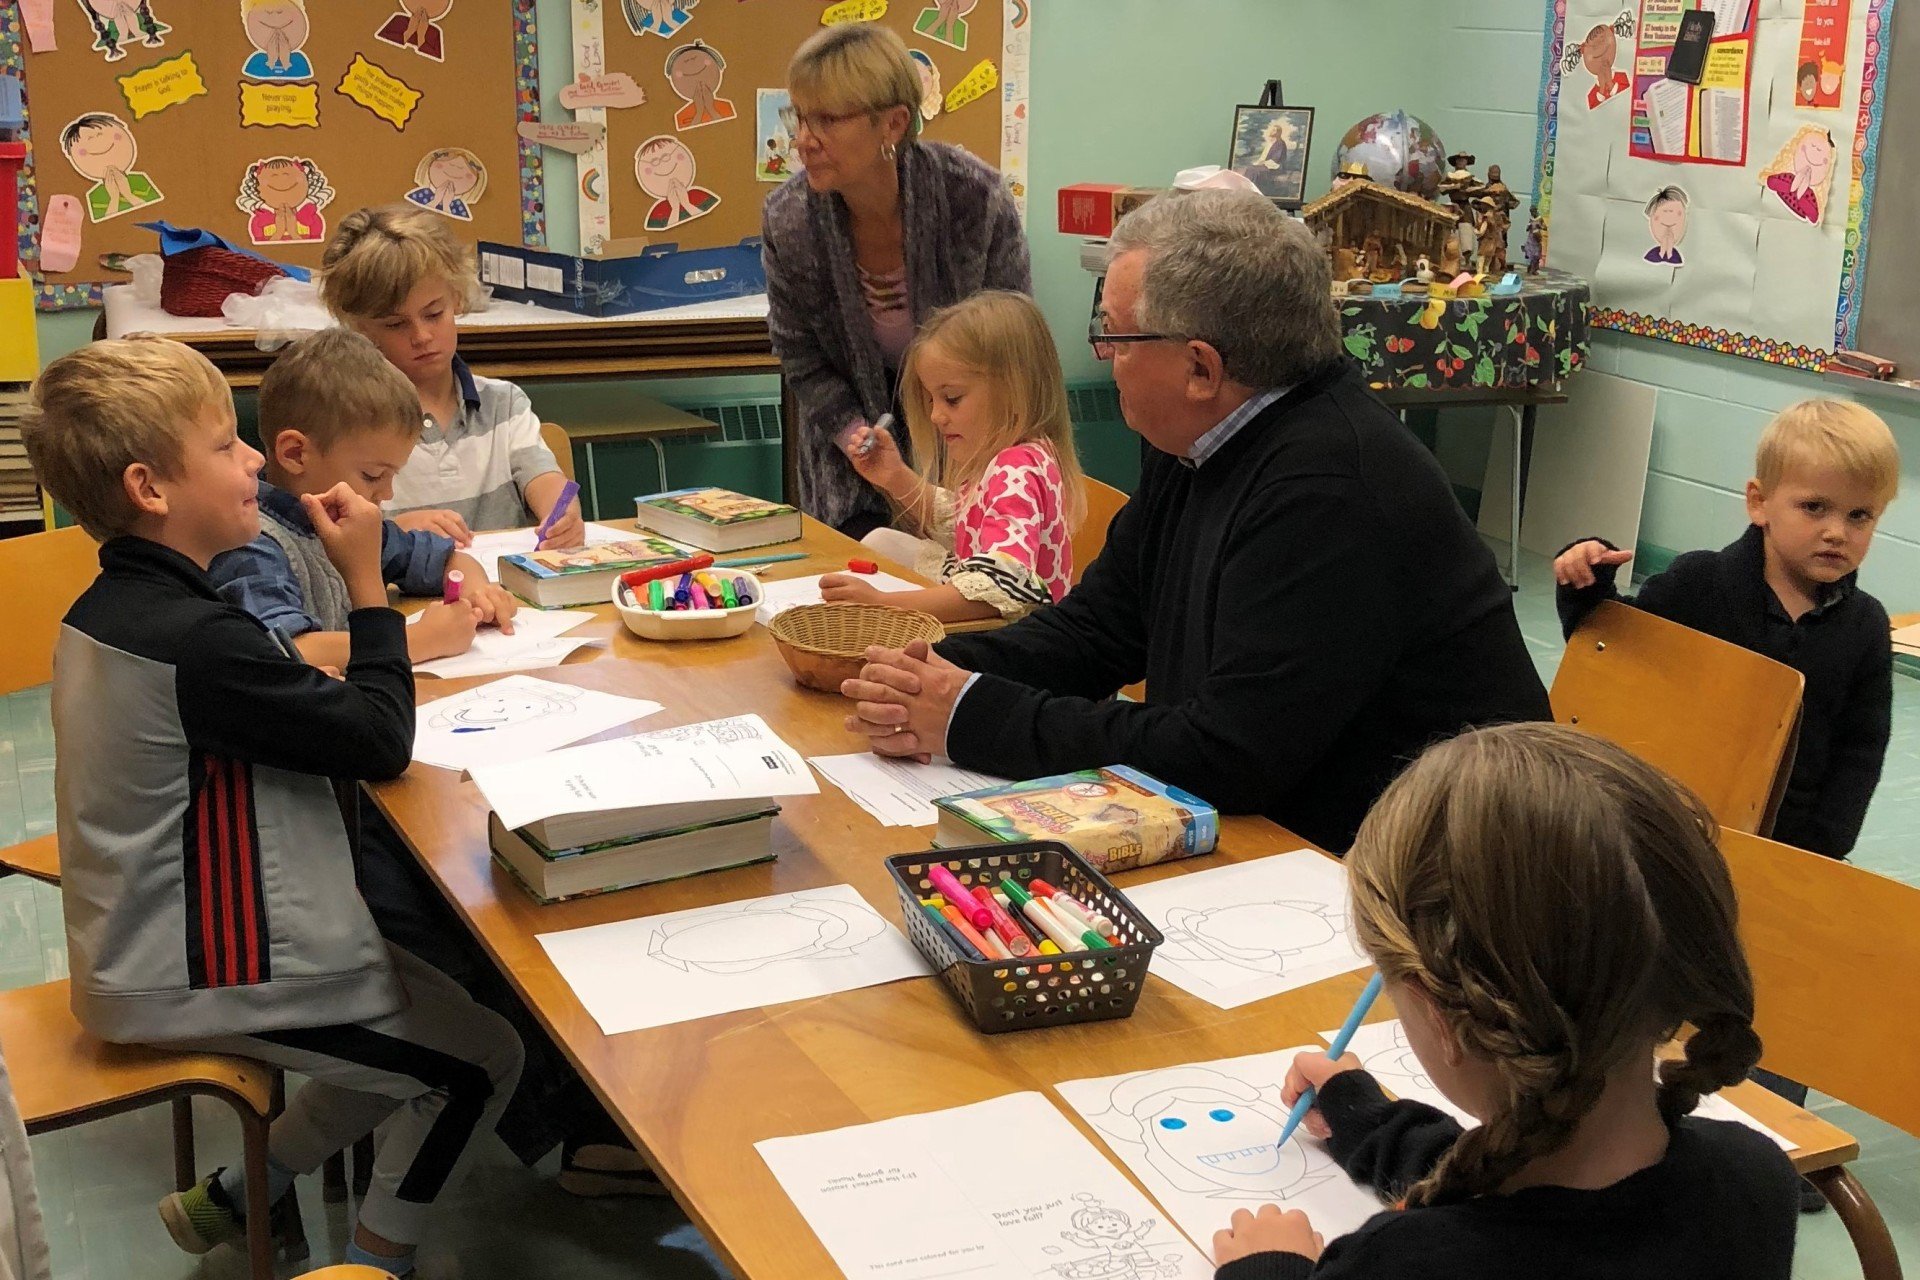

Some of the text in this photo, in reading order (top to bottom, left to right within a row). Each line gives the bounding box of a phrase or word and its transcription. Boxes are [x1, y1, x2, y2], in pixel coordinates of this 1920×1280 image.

[1107, 843, 1143, 863] BIBLE
[992, 1199, 1063, 1220] Don't you just
[998, 1211, 1043, 1228] love fall?
